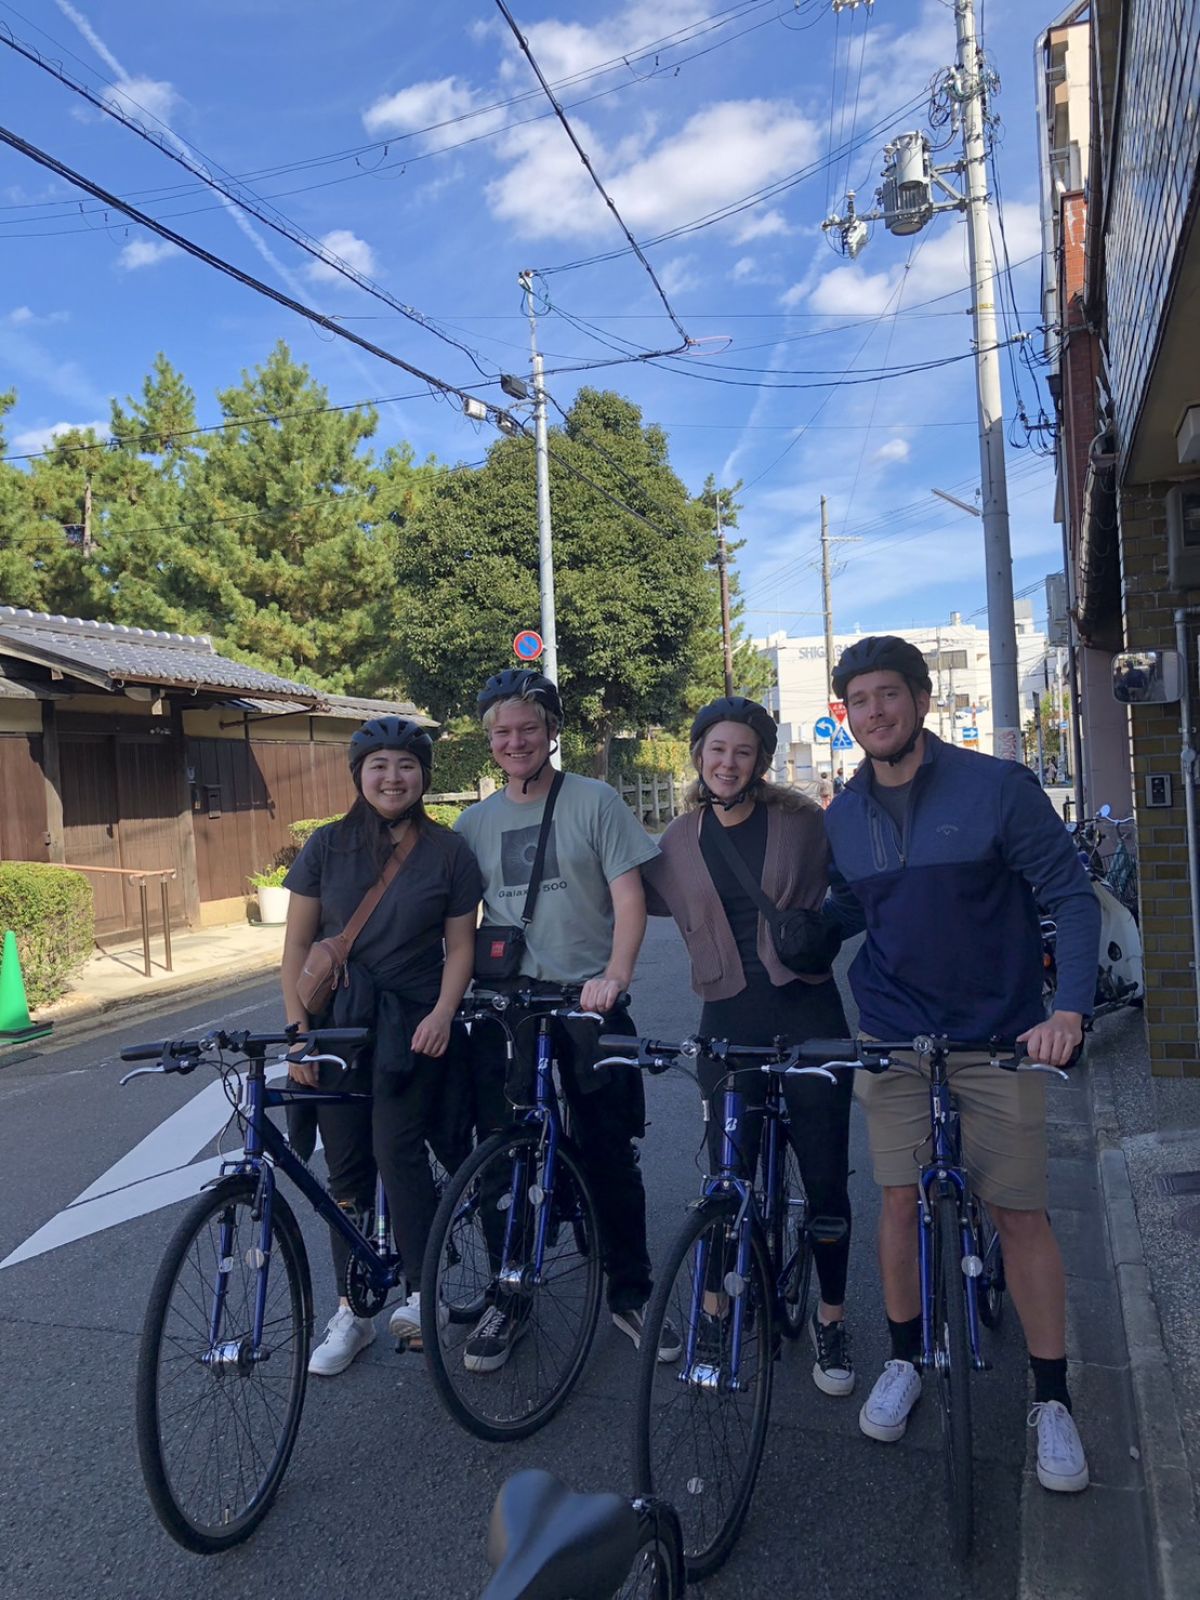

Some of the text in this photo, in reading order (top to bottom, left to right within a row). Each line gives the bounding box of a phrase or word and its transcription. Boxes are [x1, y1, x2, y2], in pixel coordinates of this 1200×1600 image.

[799, 645, 827, 659] SHIG
[498, 880, 568, 898] Galax 500
